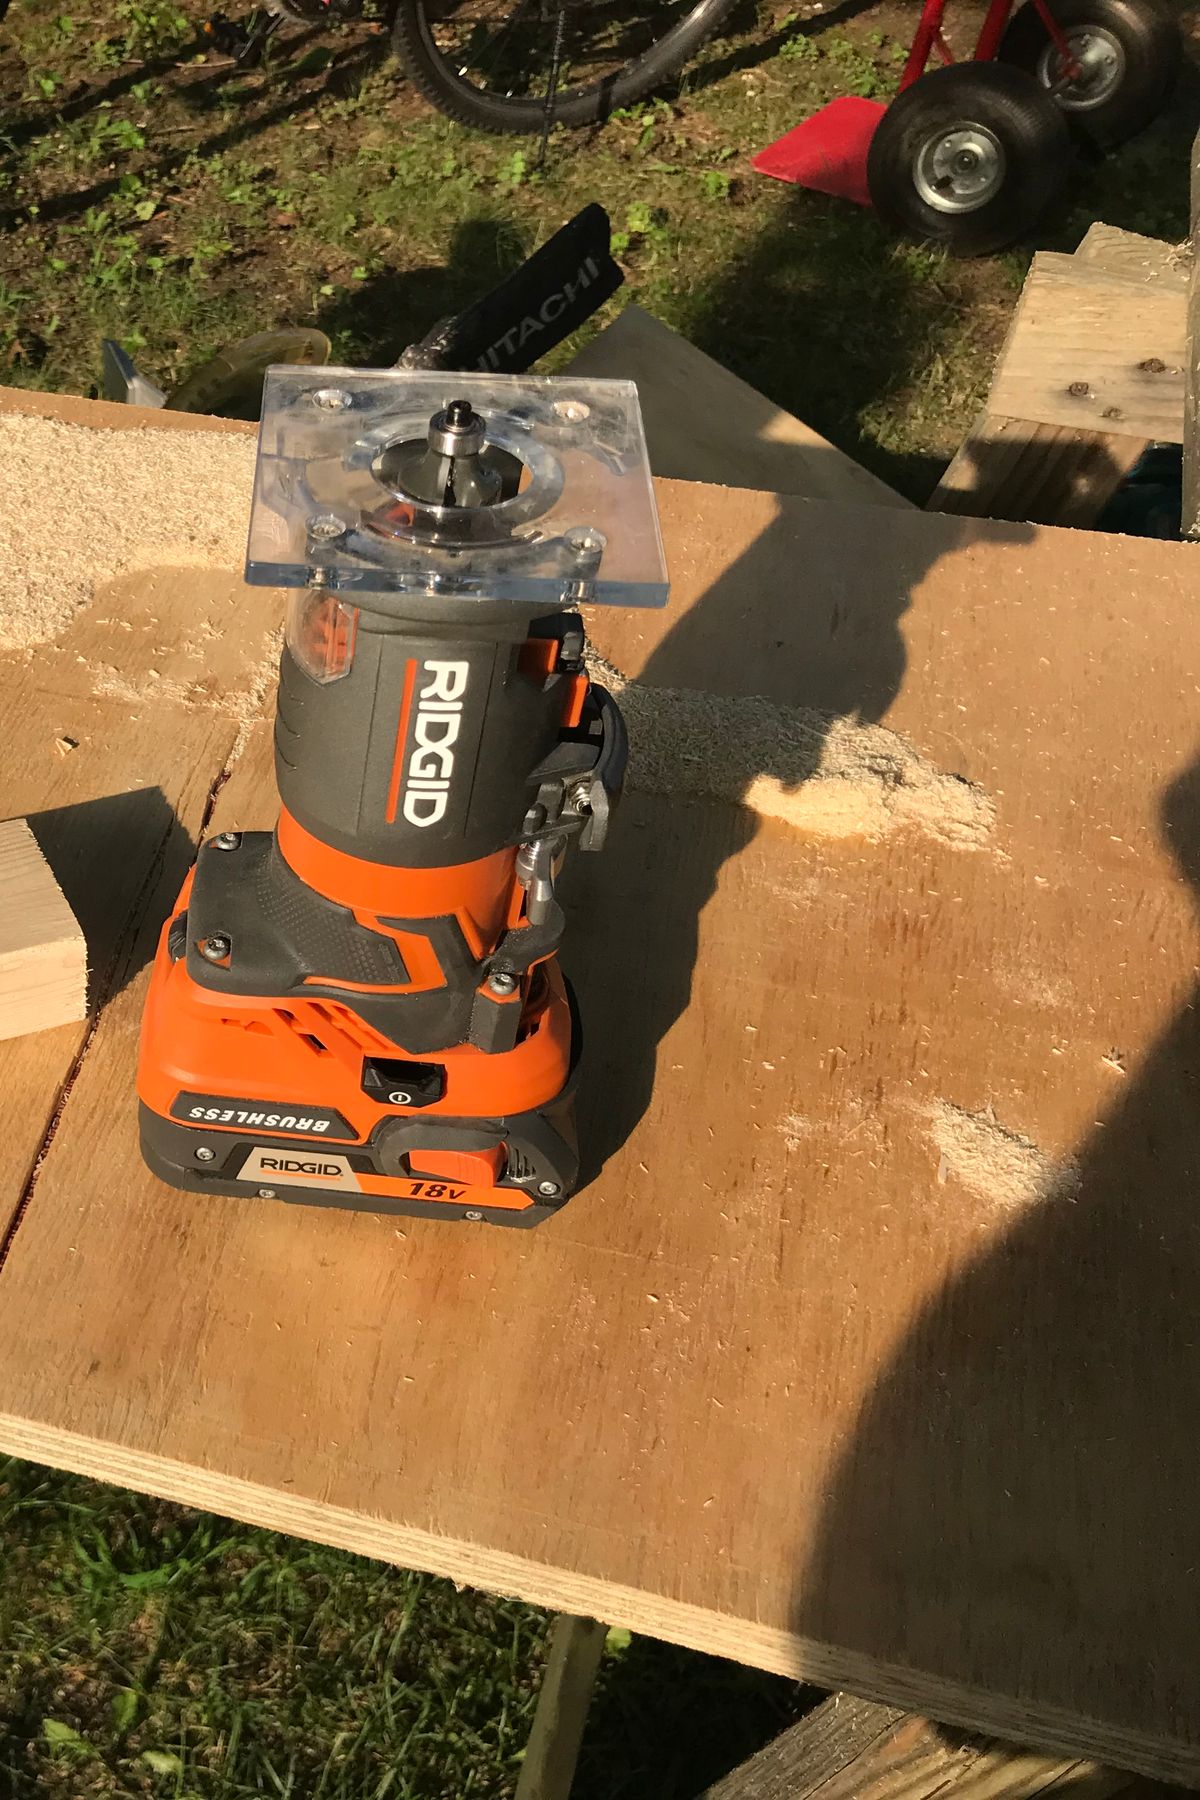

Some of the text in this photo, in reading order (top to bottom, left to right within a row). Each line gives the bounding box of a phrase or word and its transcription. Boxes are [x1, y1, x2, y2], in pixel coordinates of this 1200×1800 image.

[403, 660, 470, 828] RIDGID
[188, 1105, 331, 1134] BRUSHLESS
[259, 1156, 343, 1177] RIDGID
